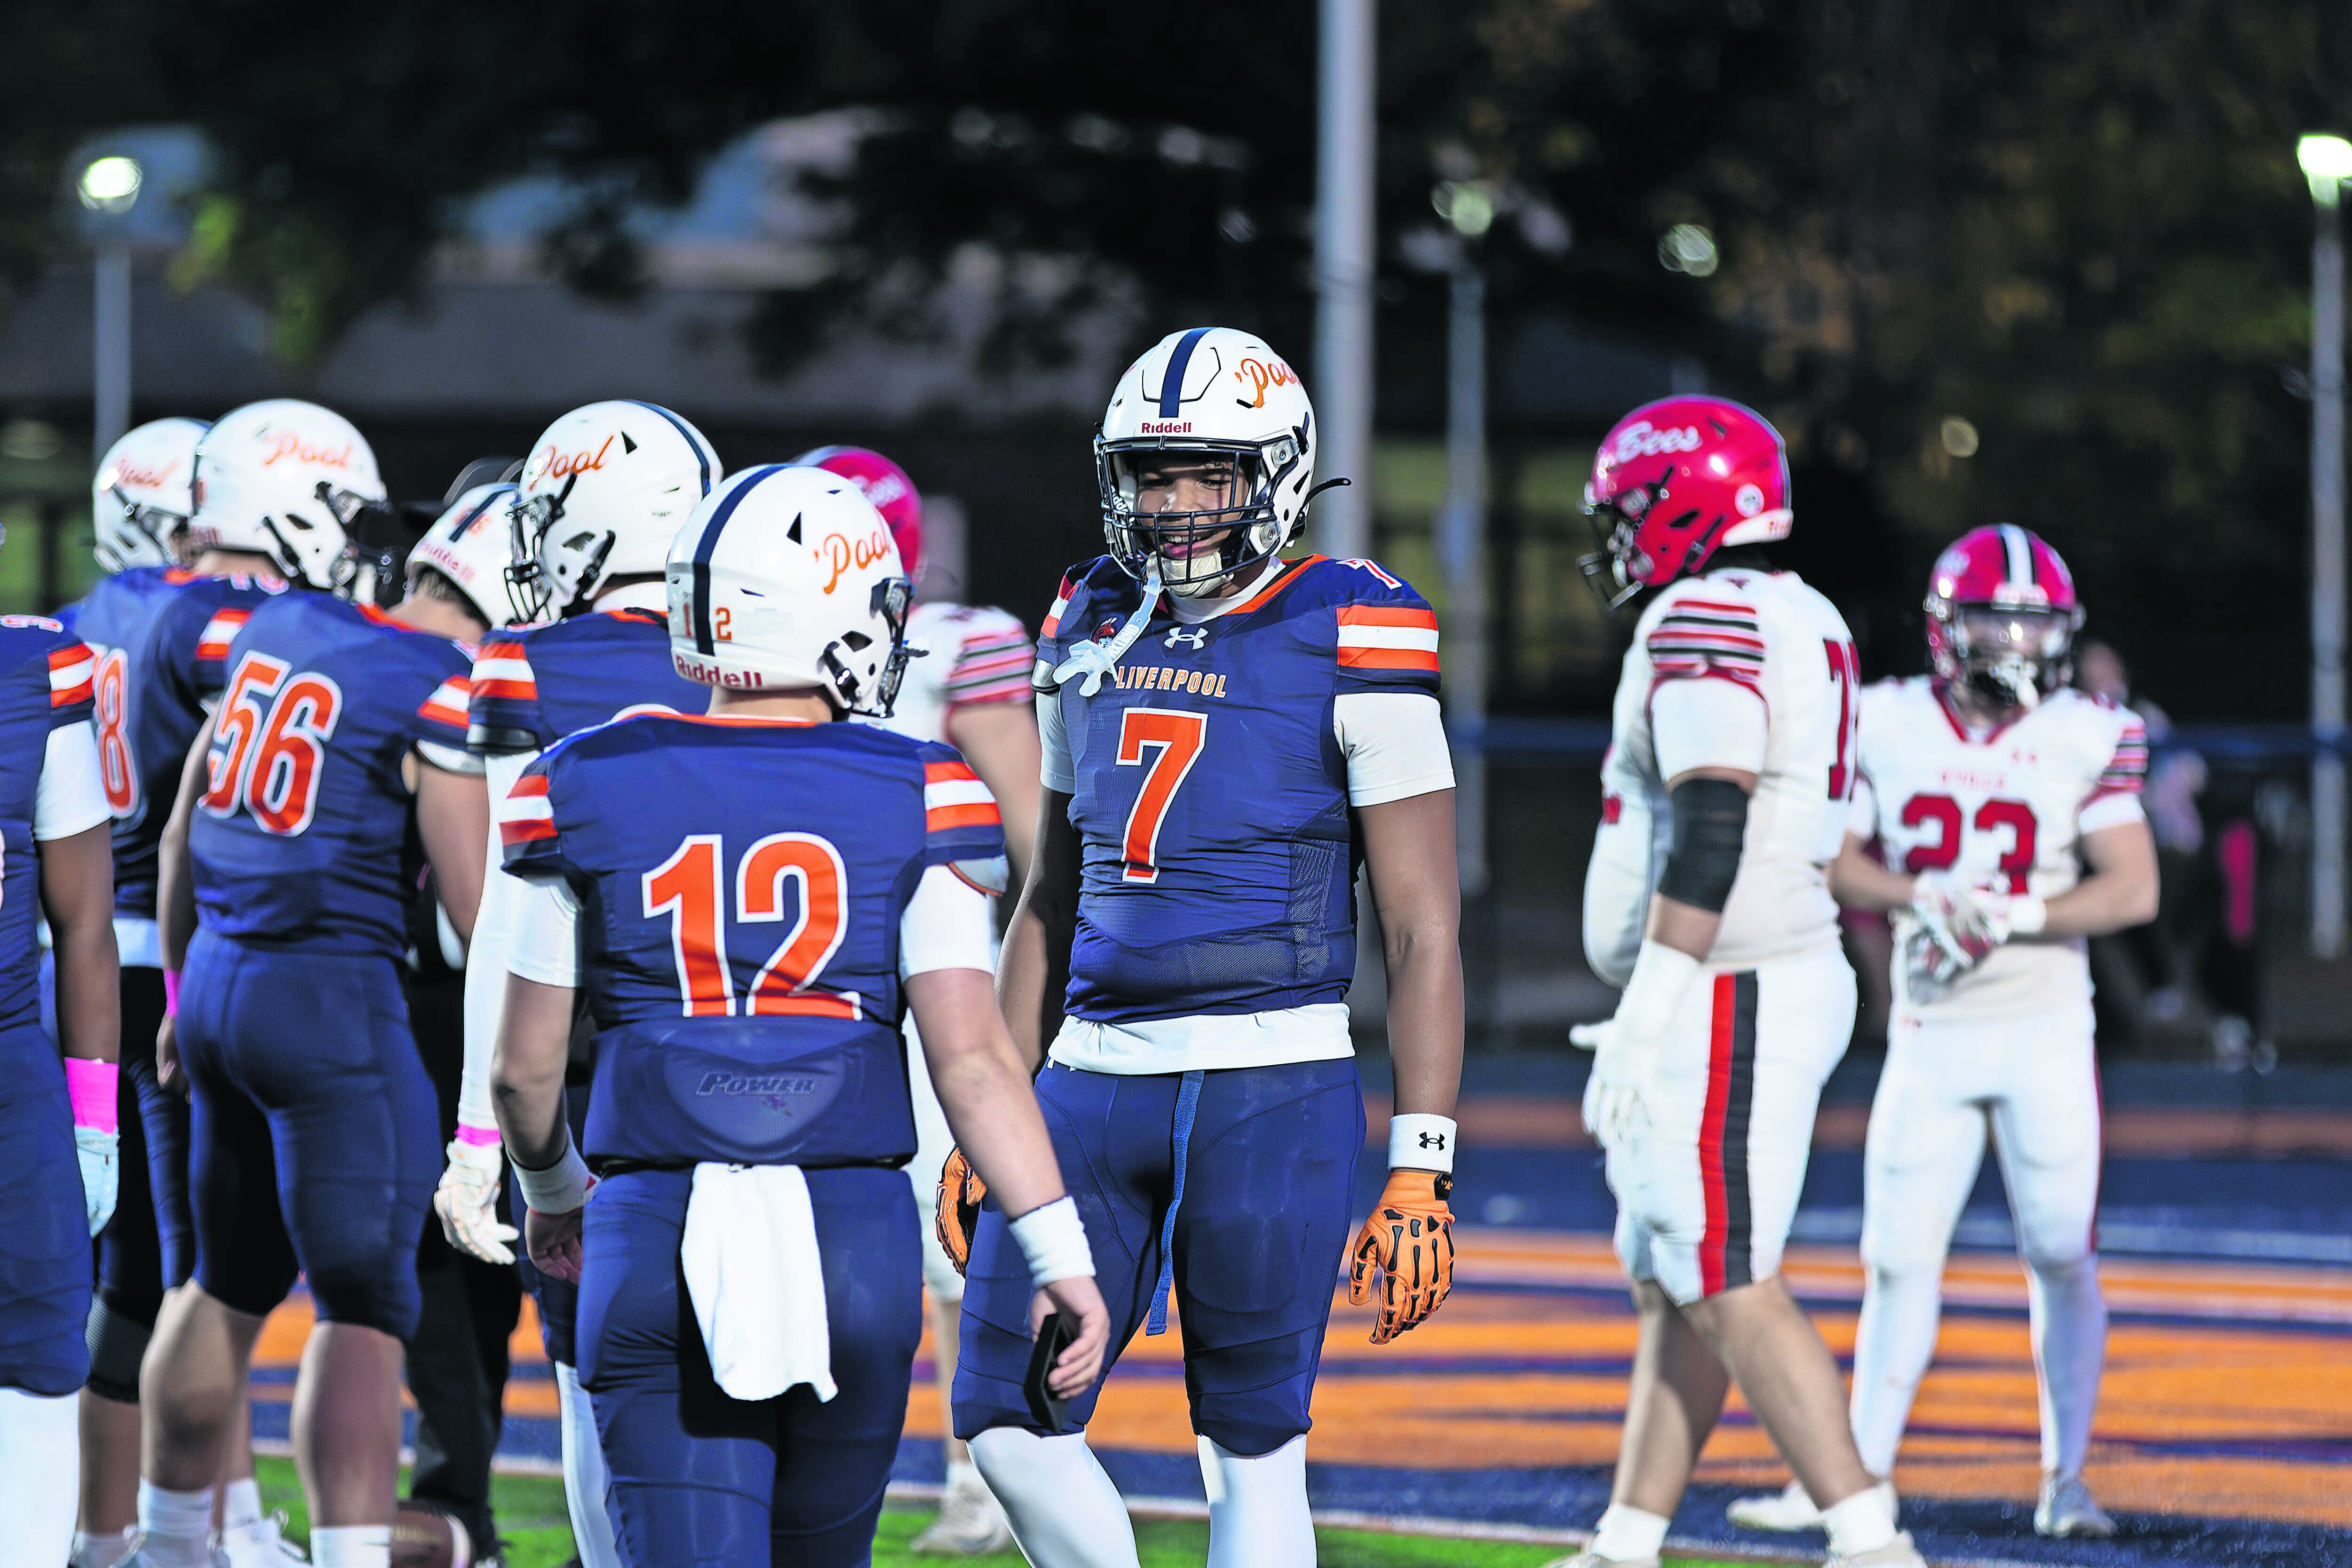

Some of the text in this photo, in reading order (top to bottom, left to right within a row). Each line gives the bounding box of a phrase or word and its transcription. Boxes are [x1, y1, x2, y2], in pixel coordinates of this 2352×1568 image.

[1234, 358, 1302, 408] 'Poo
[1141, 422, 1192, 433] Riddell
[675, 654, 762, 688] Riddell
[1115, 665, 1227, 699] LIVERPOOL
[197, 649, 344, 838] 56
[1115, 706, 1208, 885] 7
[1900, 792, 2038, 896] 23
[641, 831, 863, 1021] 12
